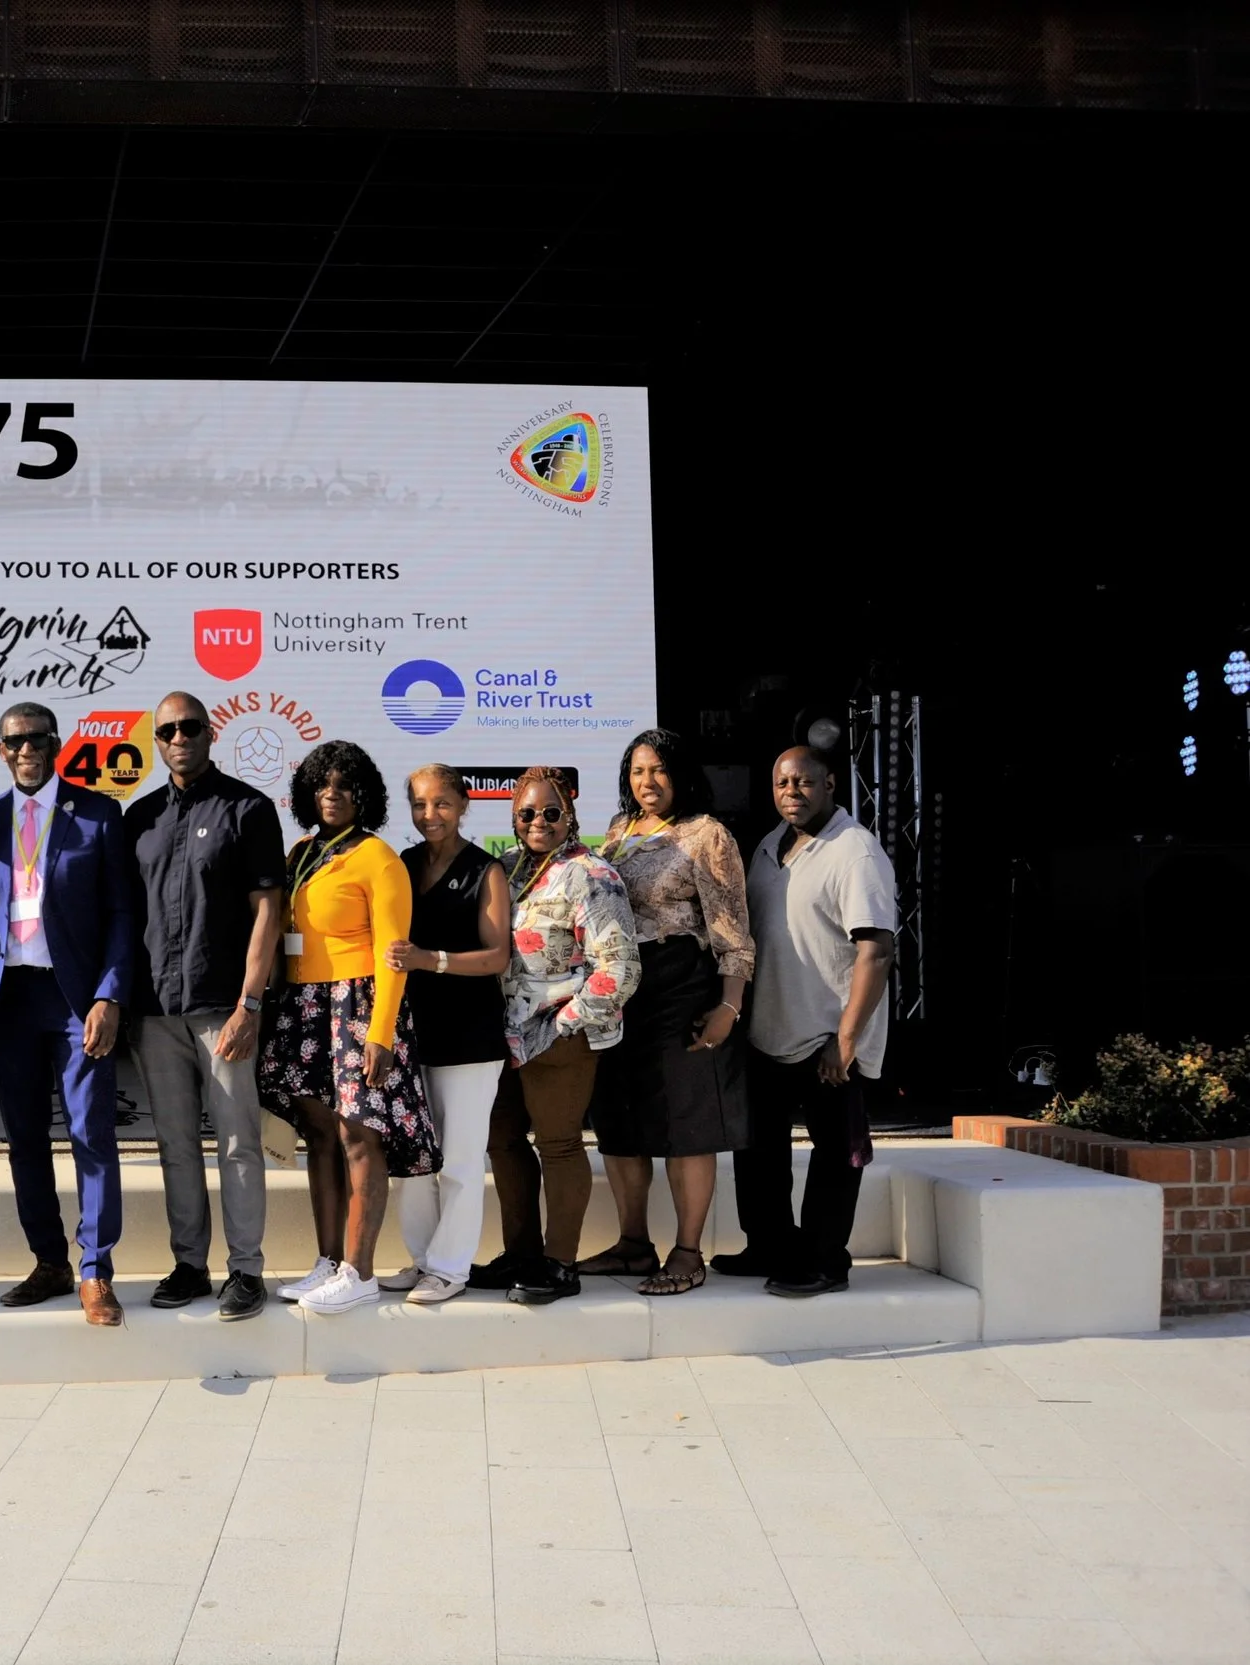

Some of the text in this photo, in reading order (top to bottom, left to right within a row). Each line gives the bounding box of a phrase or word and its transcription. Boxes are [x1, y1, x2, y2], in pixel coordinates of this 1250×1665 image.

[496, 400, 573, 455] ANNIVERSARY
[598, 412, 614, 507] CELEBRATIONS
[496, 468, 583, 518] NOTTINGHAM
[0, 561, 51, 580] YOU
[57, 561, 90, 580] TO
[96, 561, 141, 580] ALL
[147, 561, 179, 580] OF
[185, 561, 238, 580] OUR
[244, 561, 400, 580] SUPPORTERS
[273, 611, 468, 634] Nottingham Trent
[202, 628, 253, 645] NTU
[274, 635, 386, 656] University
[475, 668, 558, 687] Canal &
[476, 690, 593, 708] River Trust
[270, 692, 322, 742] YARD
[477, 715, 635, 730] Making life better by water
[63, 742, 144, 786] 40
[111, 769, 140, 777] YEARS
